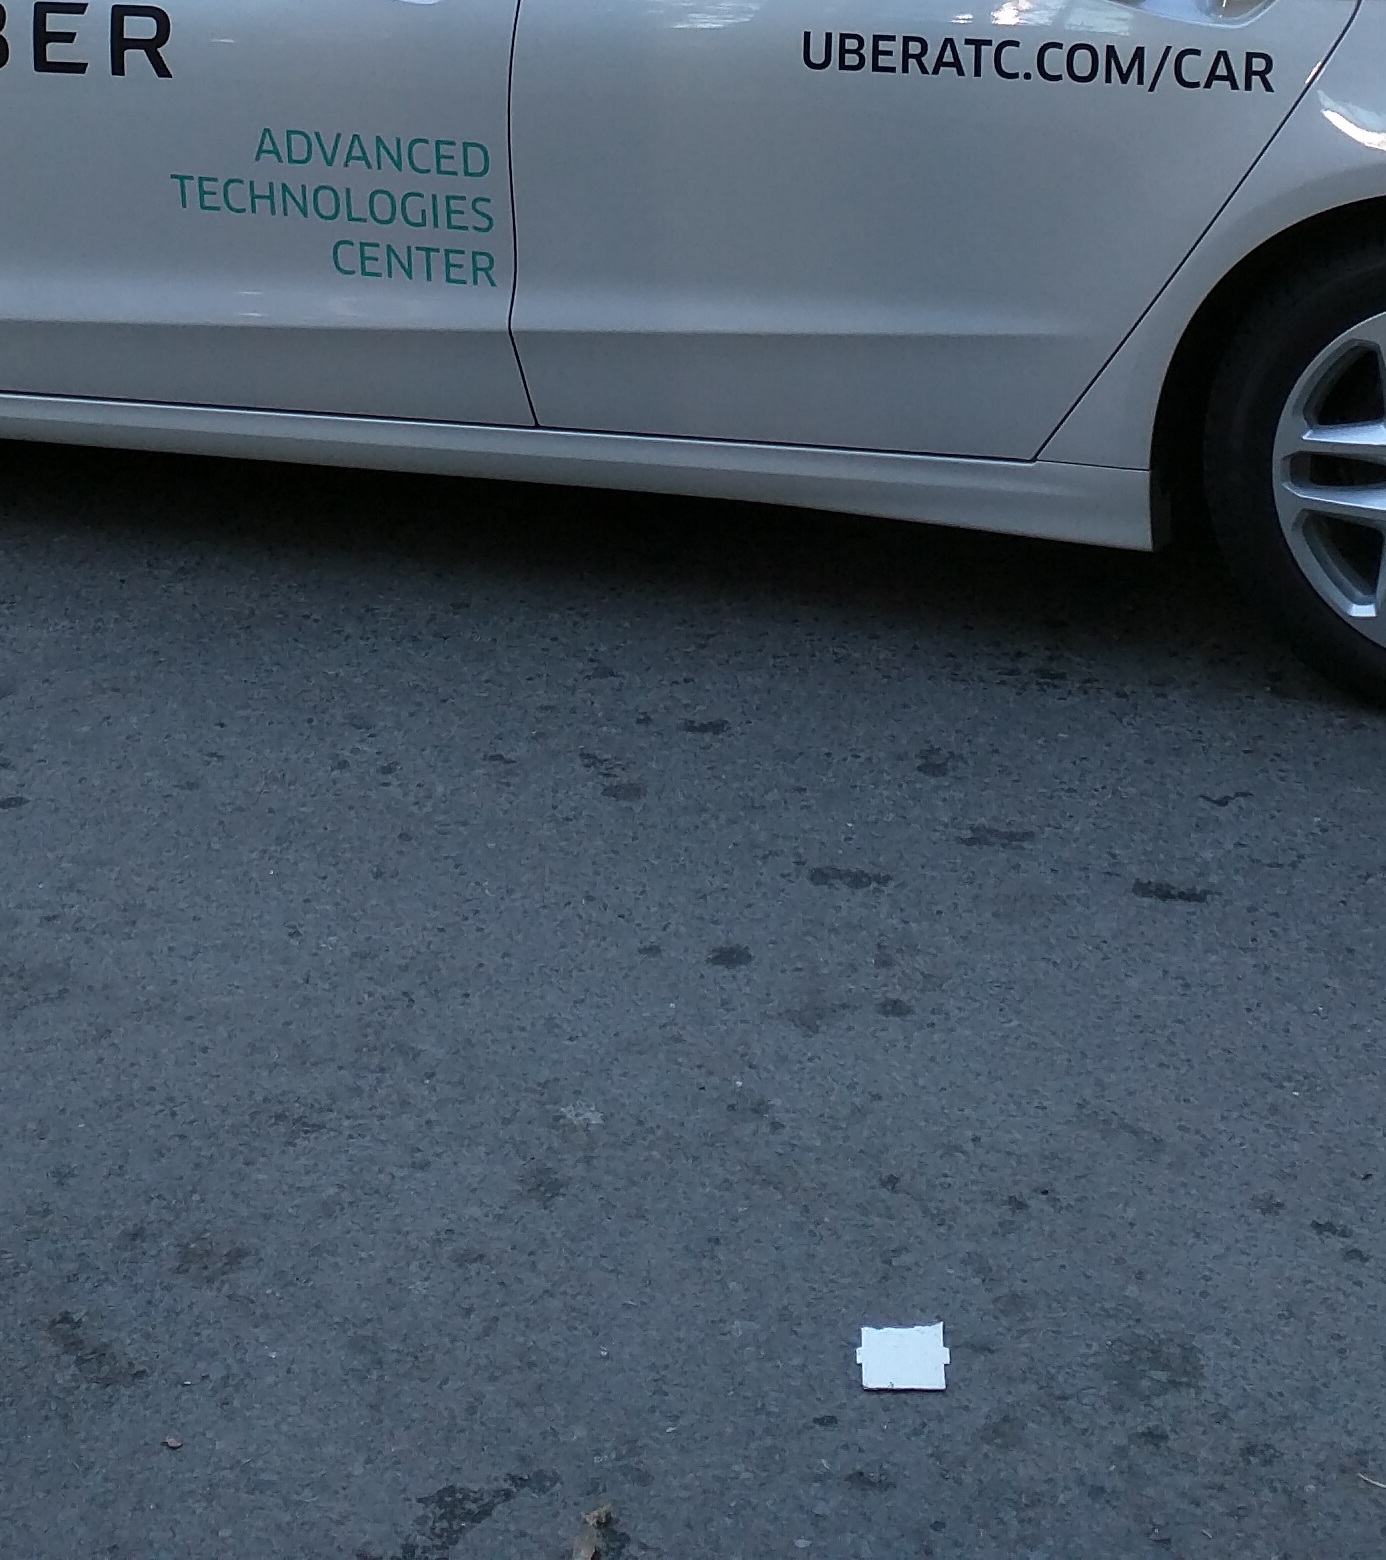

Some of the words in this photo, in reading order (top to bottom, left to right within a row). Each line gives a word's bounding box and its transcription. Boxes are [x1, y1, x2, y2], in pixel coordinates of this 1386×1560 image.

[802, 31, 1275, 93] UBERATC.COM/CAR
[254, 127, 491, 178] ADVANCED
[169, 173, 495, 233] TECHNOLOGIES
[331, 239, 498, 287] CENTER
